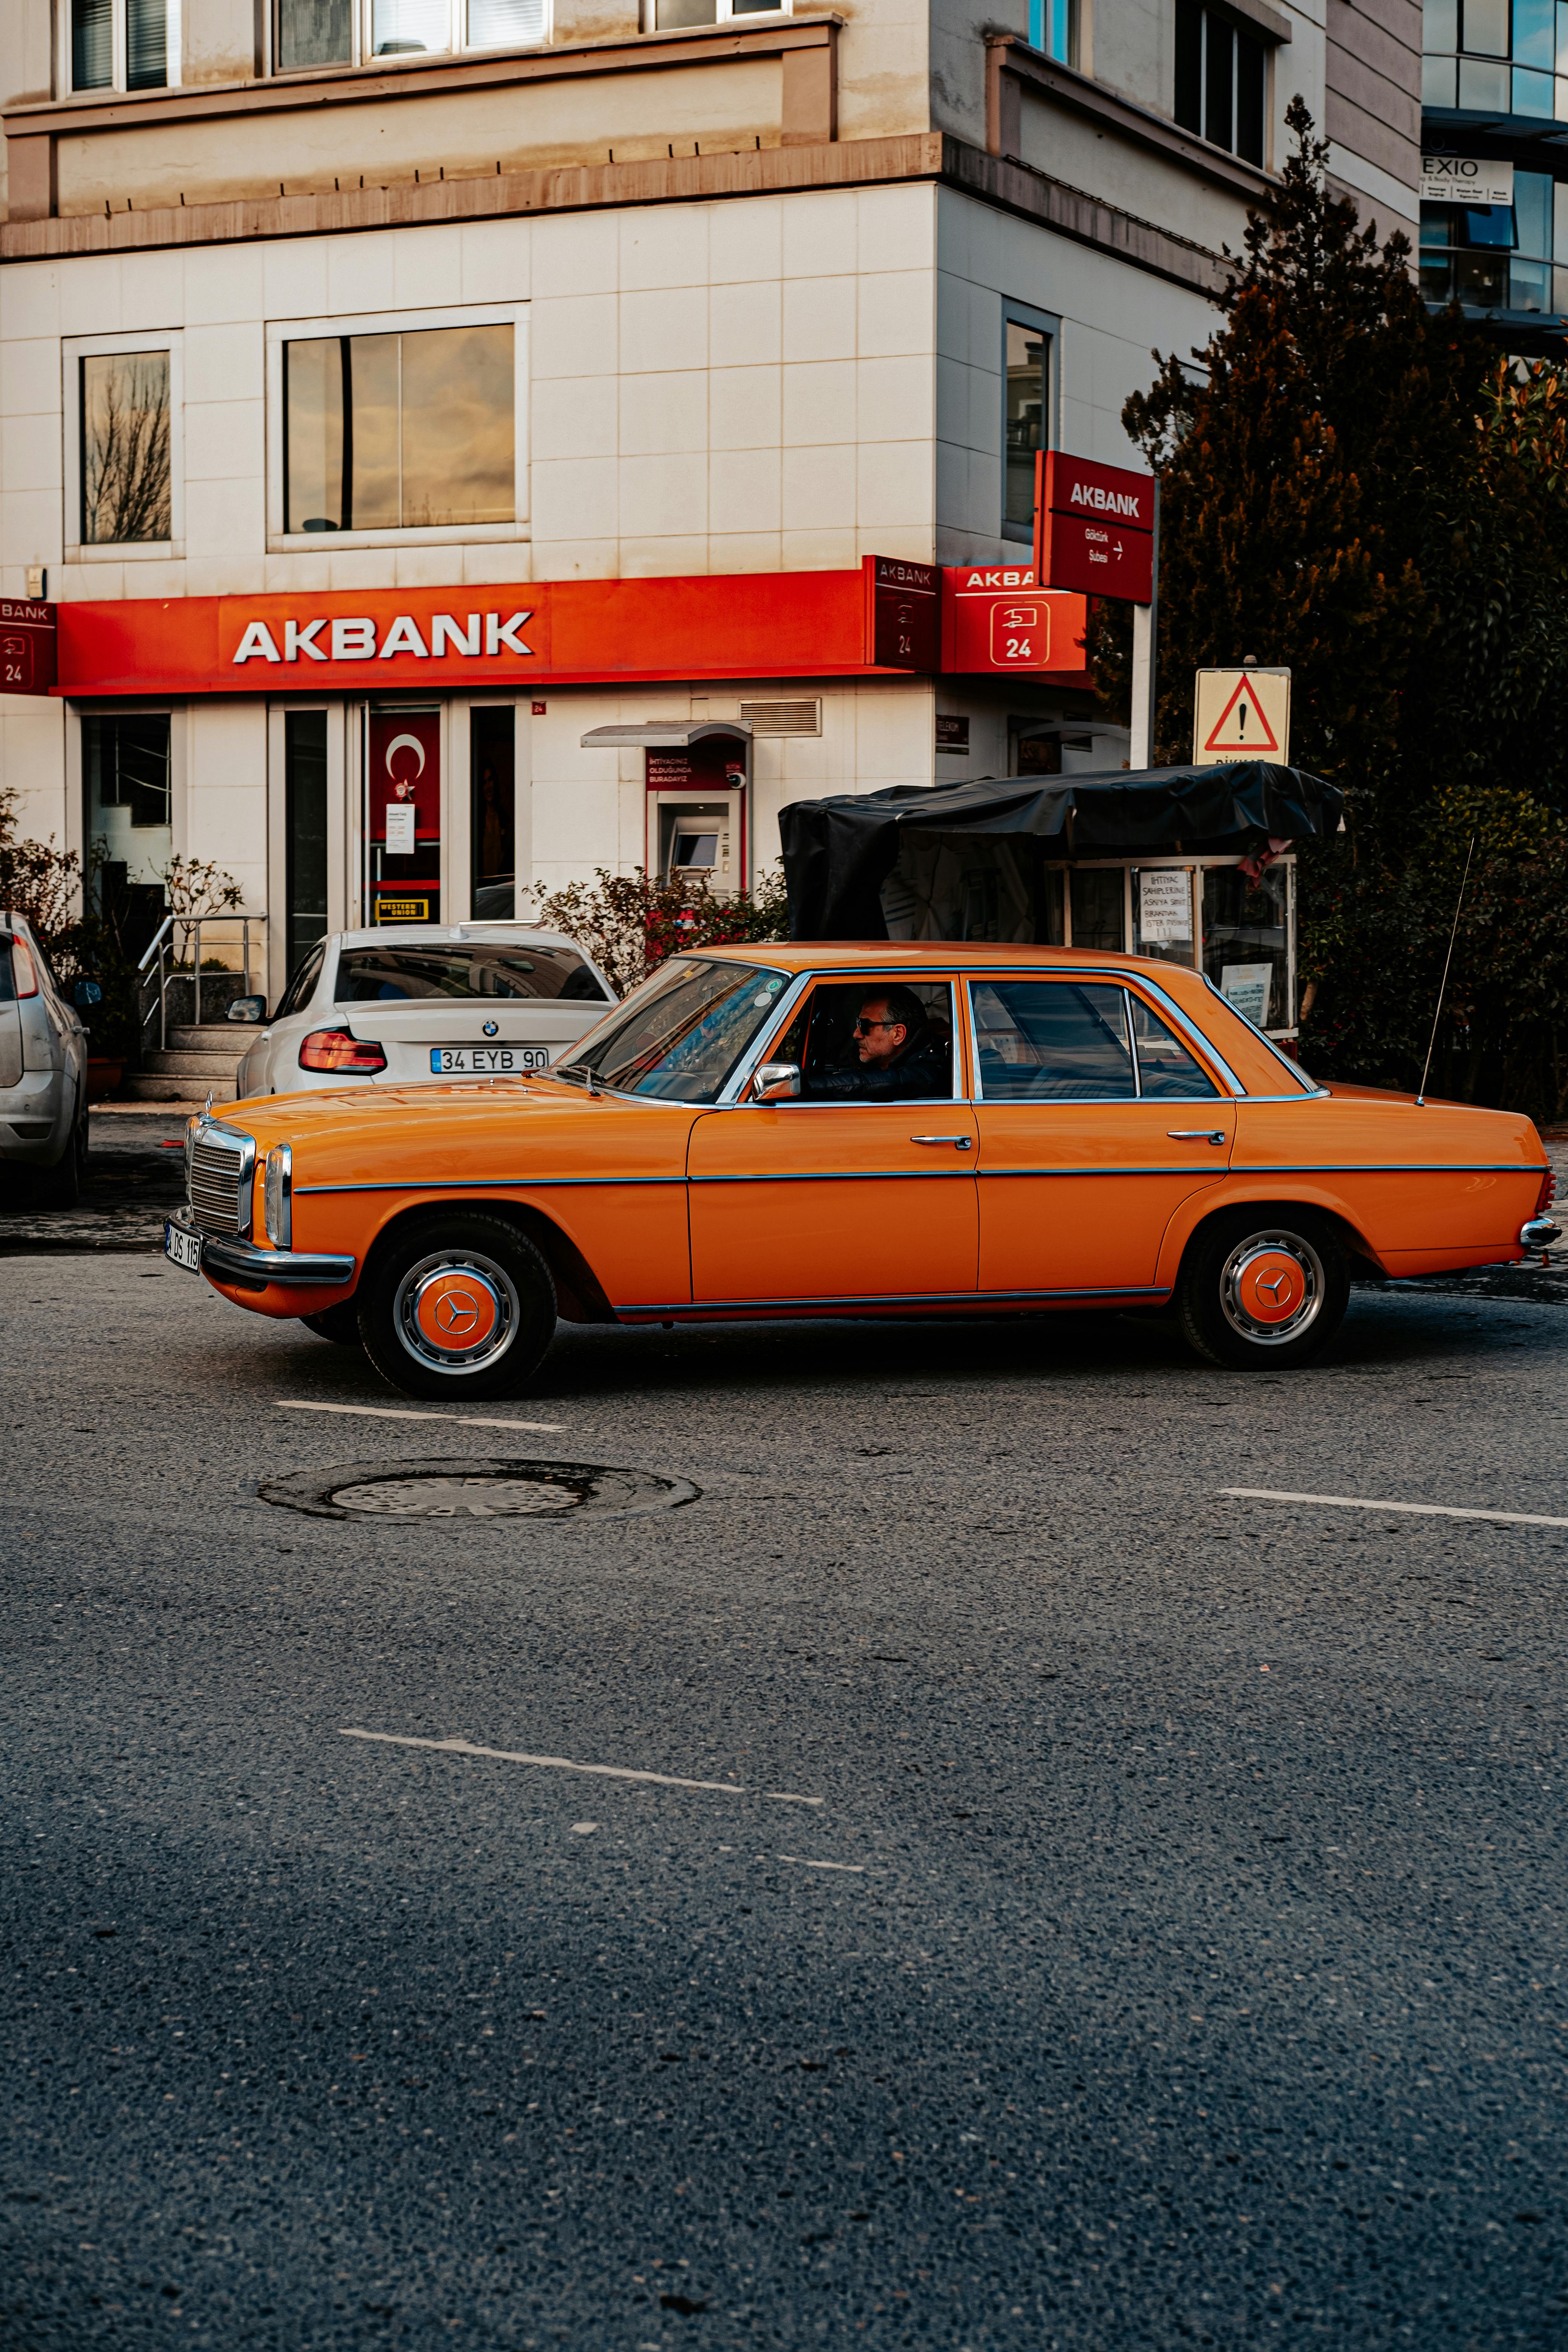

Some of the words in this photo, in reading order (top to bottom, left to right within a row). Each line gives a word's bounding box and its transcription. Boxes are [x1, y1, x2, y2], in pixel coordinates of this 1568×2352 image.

[1423, 158, 1478, 177] EXIO
[1070, 483, 1139, 518] AKBANK
[1085, 528, 1109, 542] Göktürk
[1089, 549, 1108, 564] Şubesi
[880, 564, 931, 585] AKBANK
[2, 604, 48, 620] BANK
[233, 612, 533, 663] AKBANK
[899, 635, 911, 654] 24
[1006, 639, 1032, 657] 24
[6, 664, 21, 681] 24
[443, 1051, 465, 1070] 34
[473, 1050, 513, 1069] EYB
[523, 1051, 545, 1068] 90
[174, 1232, 183, 1260] DS
[187, 1239, 199, 1267] 115
